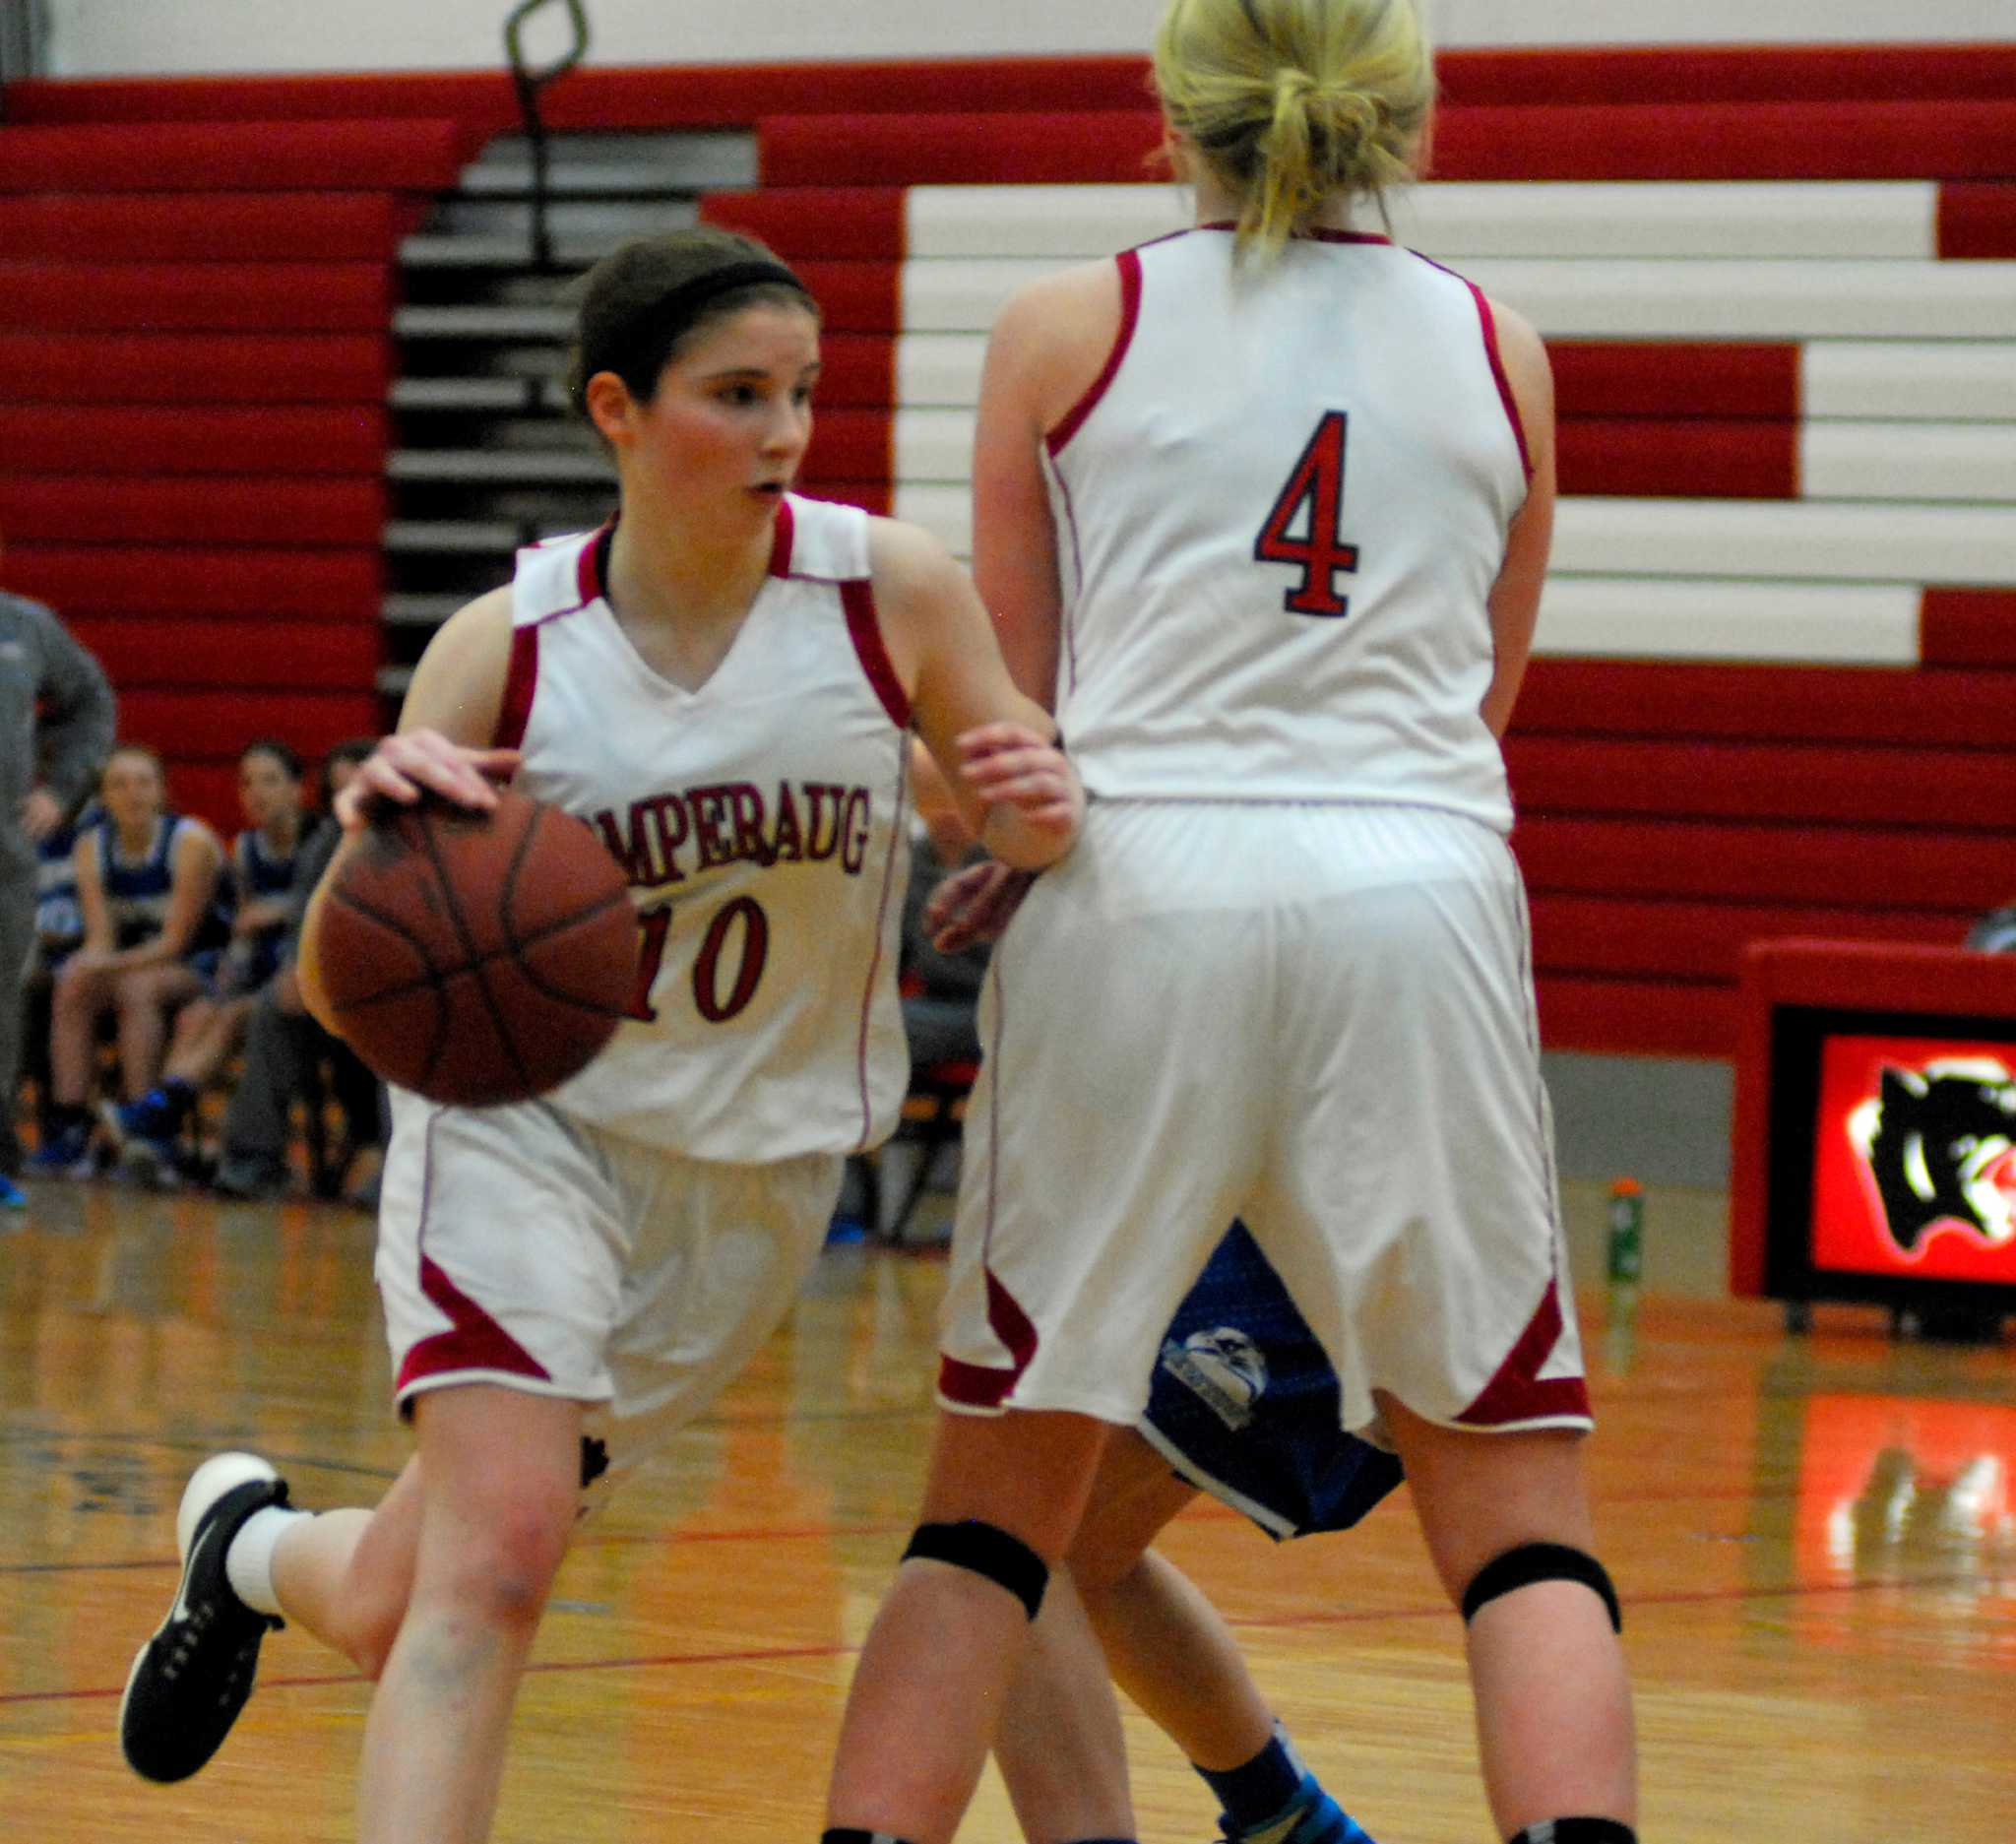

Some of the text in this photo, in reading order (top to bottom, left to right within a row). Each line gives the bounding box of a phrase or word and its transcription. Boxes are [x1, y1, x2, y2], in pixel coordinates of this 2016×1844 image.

[1254, 410, 1358, 617] 4
[583, 780, 869, 887] MPERAUG
[636, 896, 769, 1023] 10
